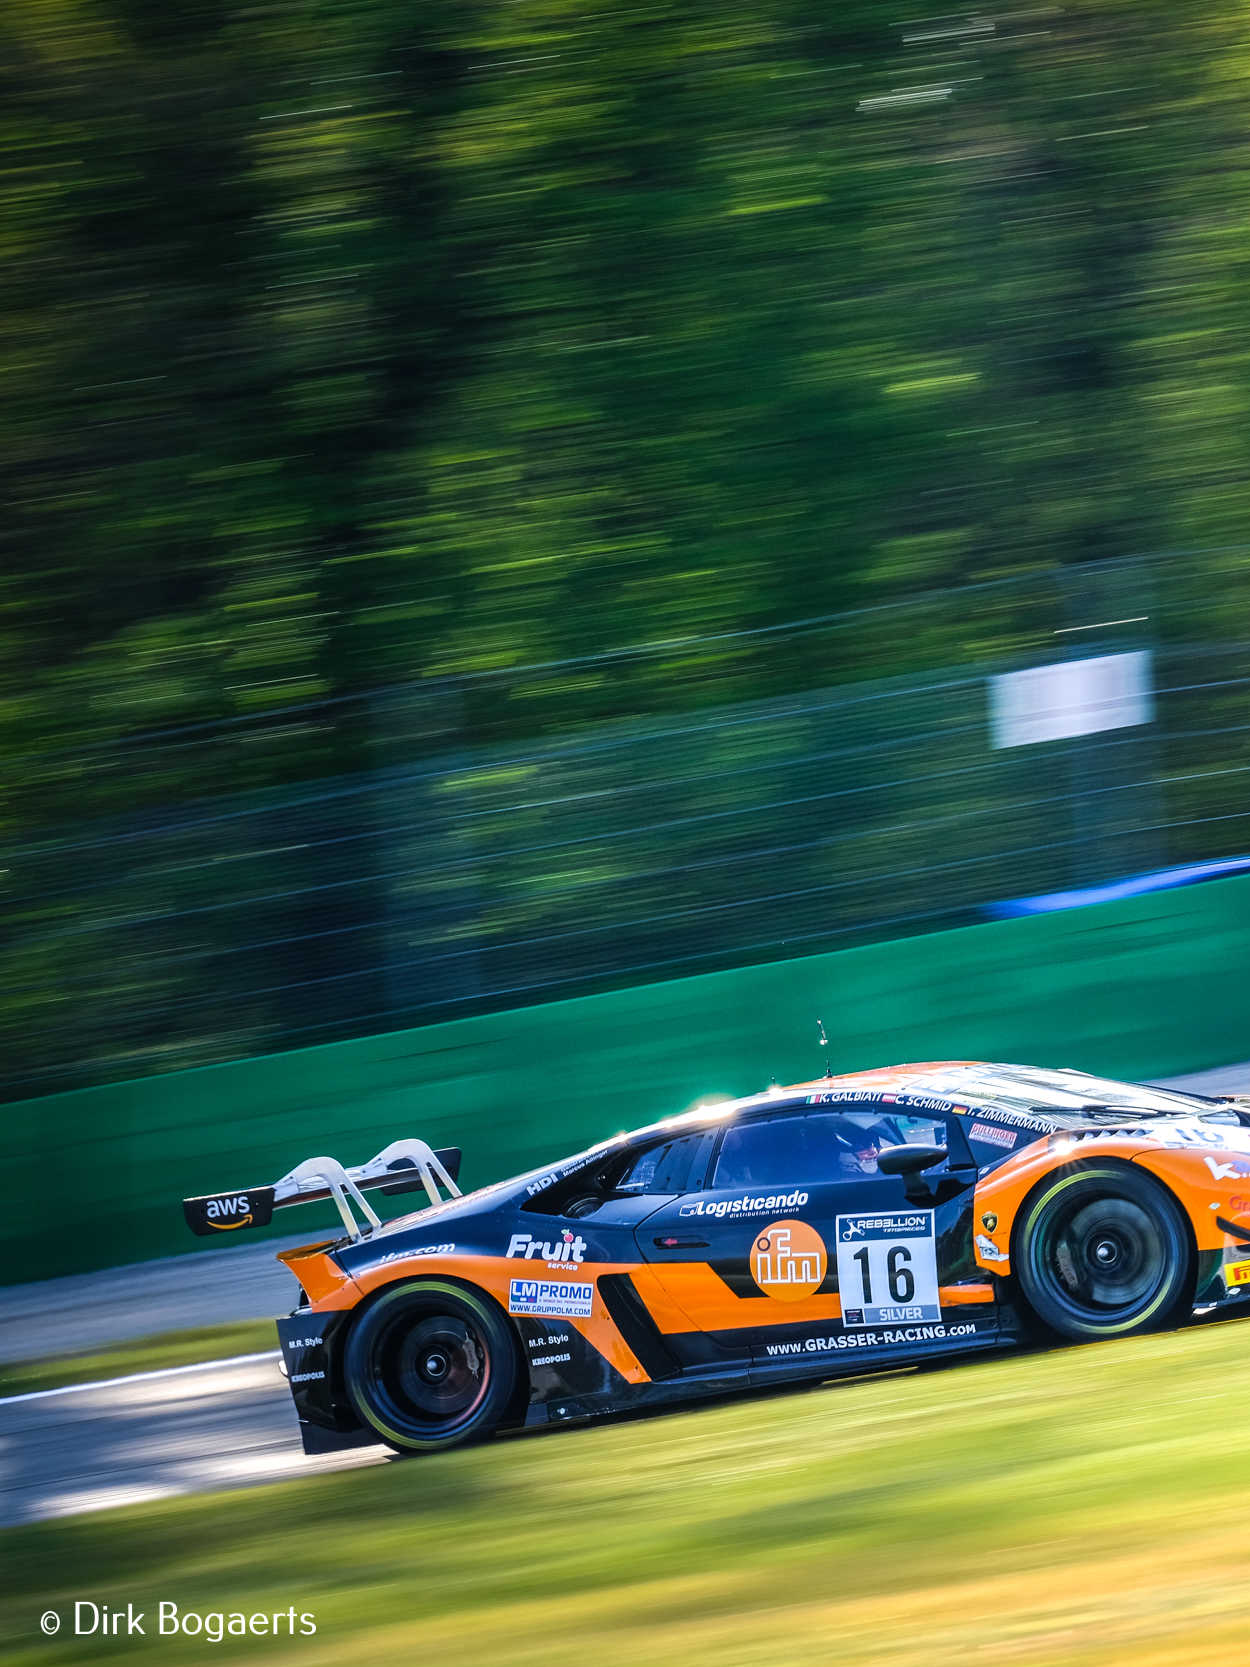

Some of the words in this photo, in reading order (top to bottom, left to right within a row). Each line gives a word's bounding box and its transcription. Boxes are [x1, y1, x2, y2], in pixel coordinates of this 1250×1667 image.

[819, 1093, 830, 1103] K.
[831, 1091, 882, 1103] GALBIATI
[895, 1094, 905, 1105] C.
[906, 1095, 952, 1112] SCHMID
[976, 1107, 1057, 1135] ZIMMERMANN
[526, 1173, 559, 1197] HDI
[206, 1196, 250, 1218] aws
[696, 1190, 809, 1217] Logisticando
[857, 1217, 926, 1229] REBELLION
[505, 1228, 587, 1263] Fruit
[757, 1229, 821, 1284] ifm
[547, 1263, 578, 1271] service
[853, 1245, 915, 1305] 16
[512, 1282, 537, 1297] LM
[539, 1285, 592, 1299] PROMO
[510, 1304, 591, 1316] WWW.GRUPPOLM.COM
[880, 1307, 923, 1320] SILVER
[528, 1337, 547, 1348] M.R.
[548, 1334, 569, 1345] Style
